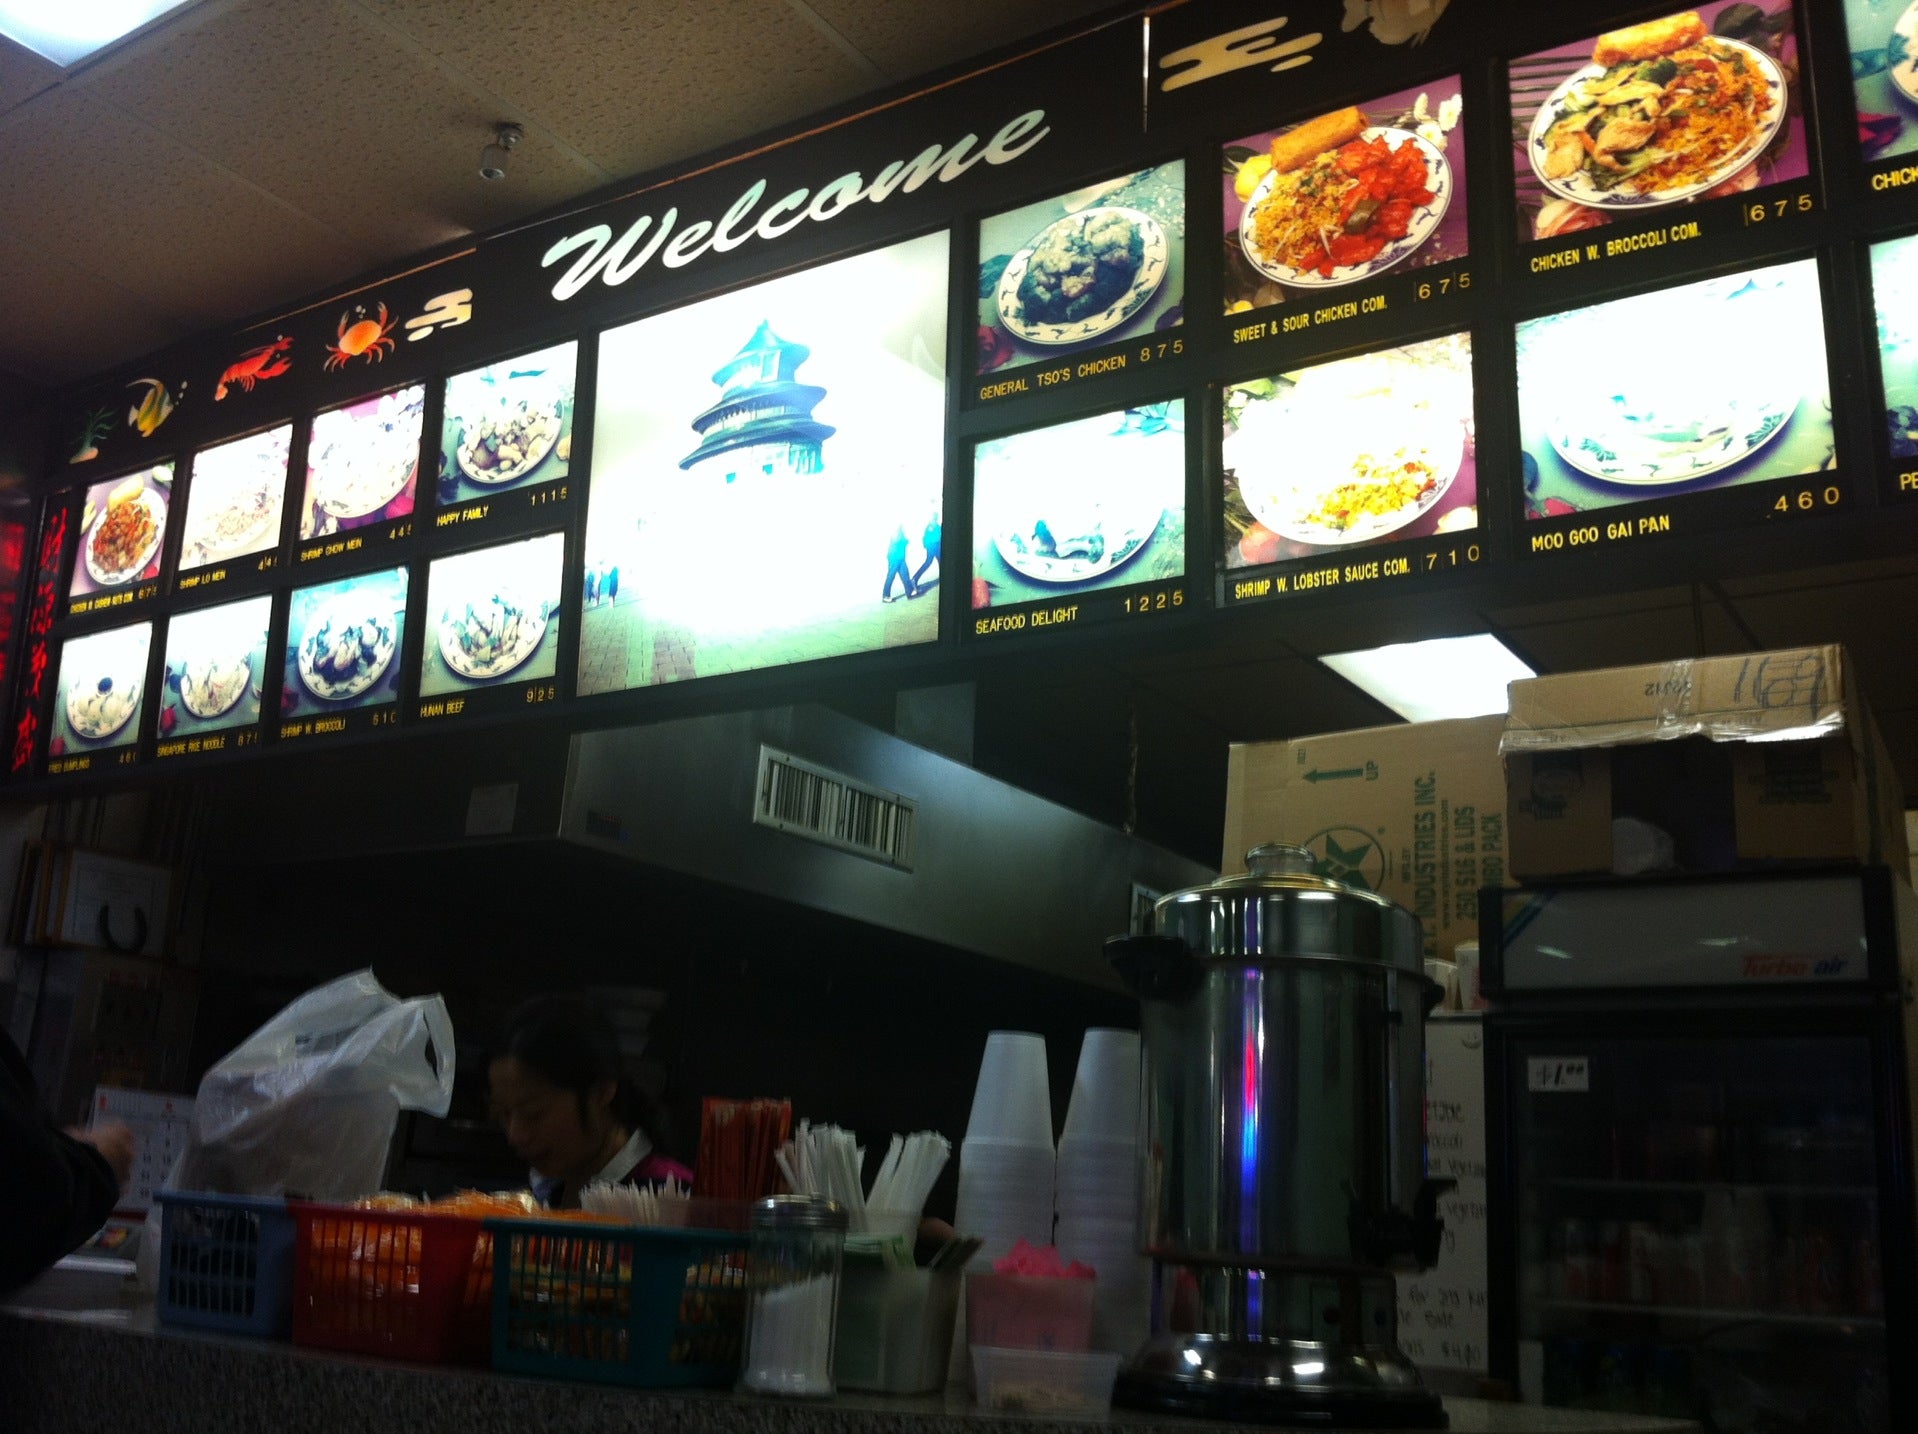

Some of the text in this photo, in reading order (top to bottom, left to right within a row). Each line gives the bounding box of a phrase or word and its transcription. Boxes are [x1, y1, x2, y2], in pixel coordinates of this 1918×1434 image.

[541, 109, 1050, 301] Welcome
[1750, 194, 1813, 222] 675
[1531, 221, 1701, 273] CHICKEN W. BROCCOLI COM.
[1418, 273, 1471, 299] 675
[1233, 295, 1387, 343] SWEET & SOUR CHICKEN COM.
[1140, 340, 1184, 362] 875
[980, 355, 1126, 400] GENERAL TSO'S CHICKEN
[1774, 486, 1840, 513] 460
[436, 505, 489, 527] HAPPY FAMILY
[1531, 515, 1670, 552] MOO GOO GAI PAN
[301, 546, 323, 562] SHRIMP
[325, 542, 345, 556] CHOW
[1426, 545, 1480, 570] 710
[1235, 557, 1410, 599] SHRIMP W. LOBSTER SAUCE COM.
[1124, 590, 1183, 614] 1225
[975, 606, 1079, 635] SEAFOOD DELIGHT
[420, 700, 464, 719] HUNAN BEEF
[1366, 760, 1379, 781] UP
[1414, 769, 1436, 806] INC.
[1455, 806, 1475, 838] LIDS
[1481, 814, 1501, 852] PACK
[1414, 811, 1436, 918] INDUSTRIES
